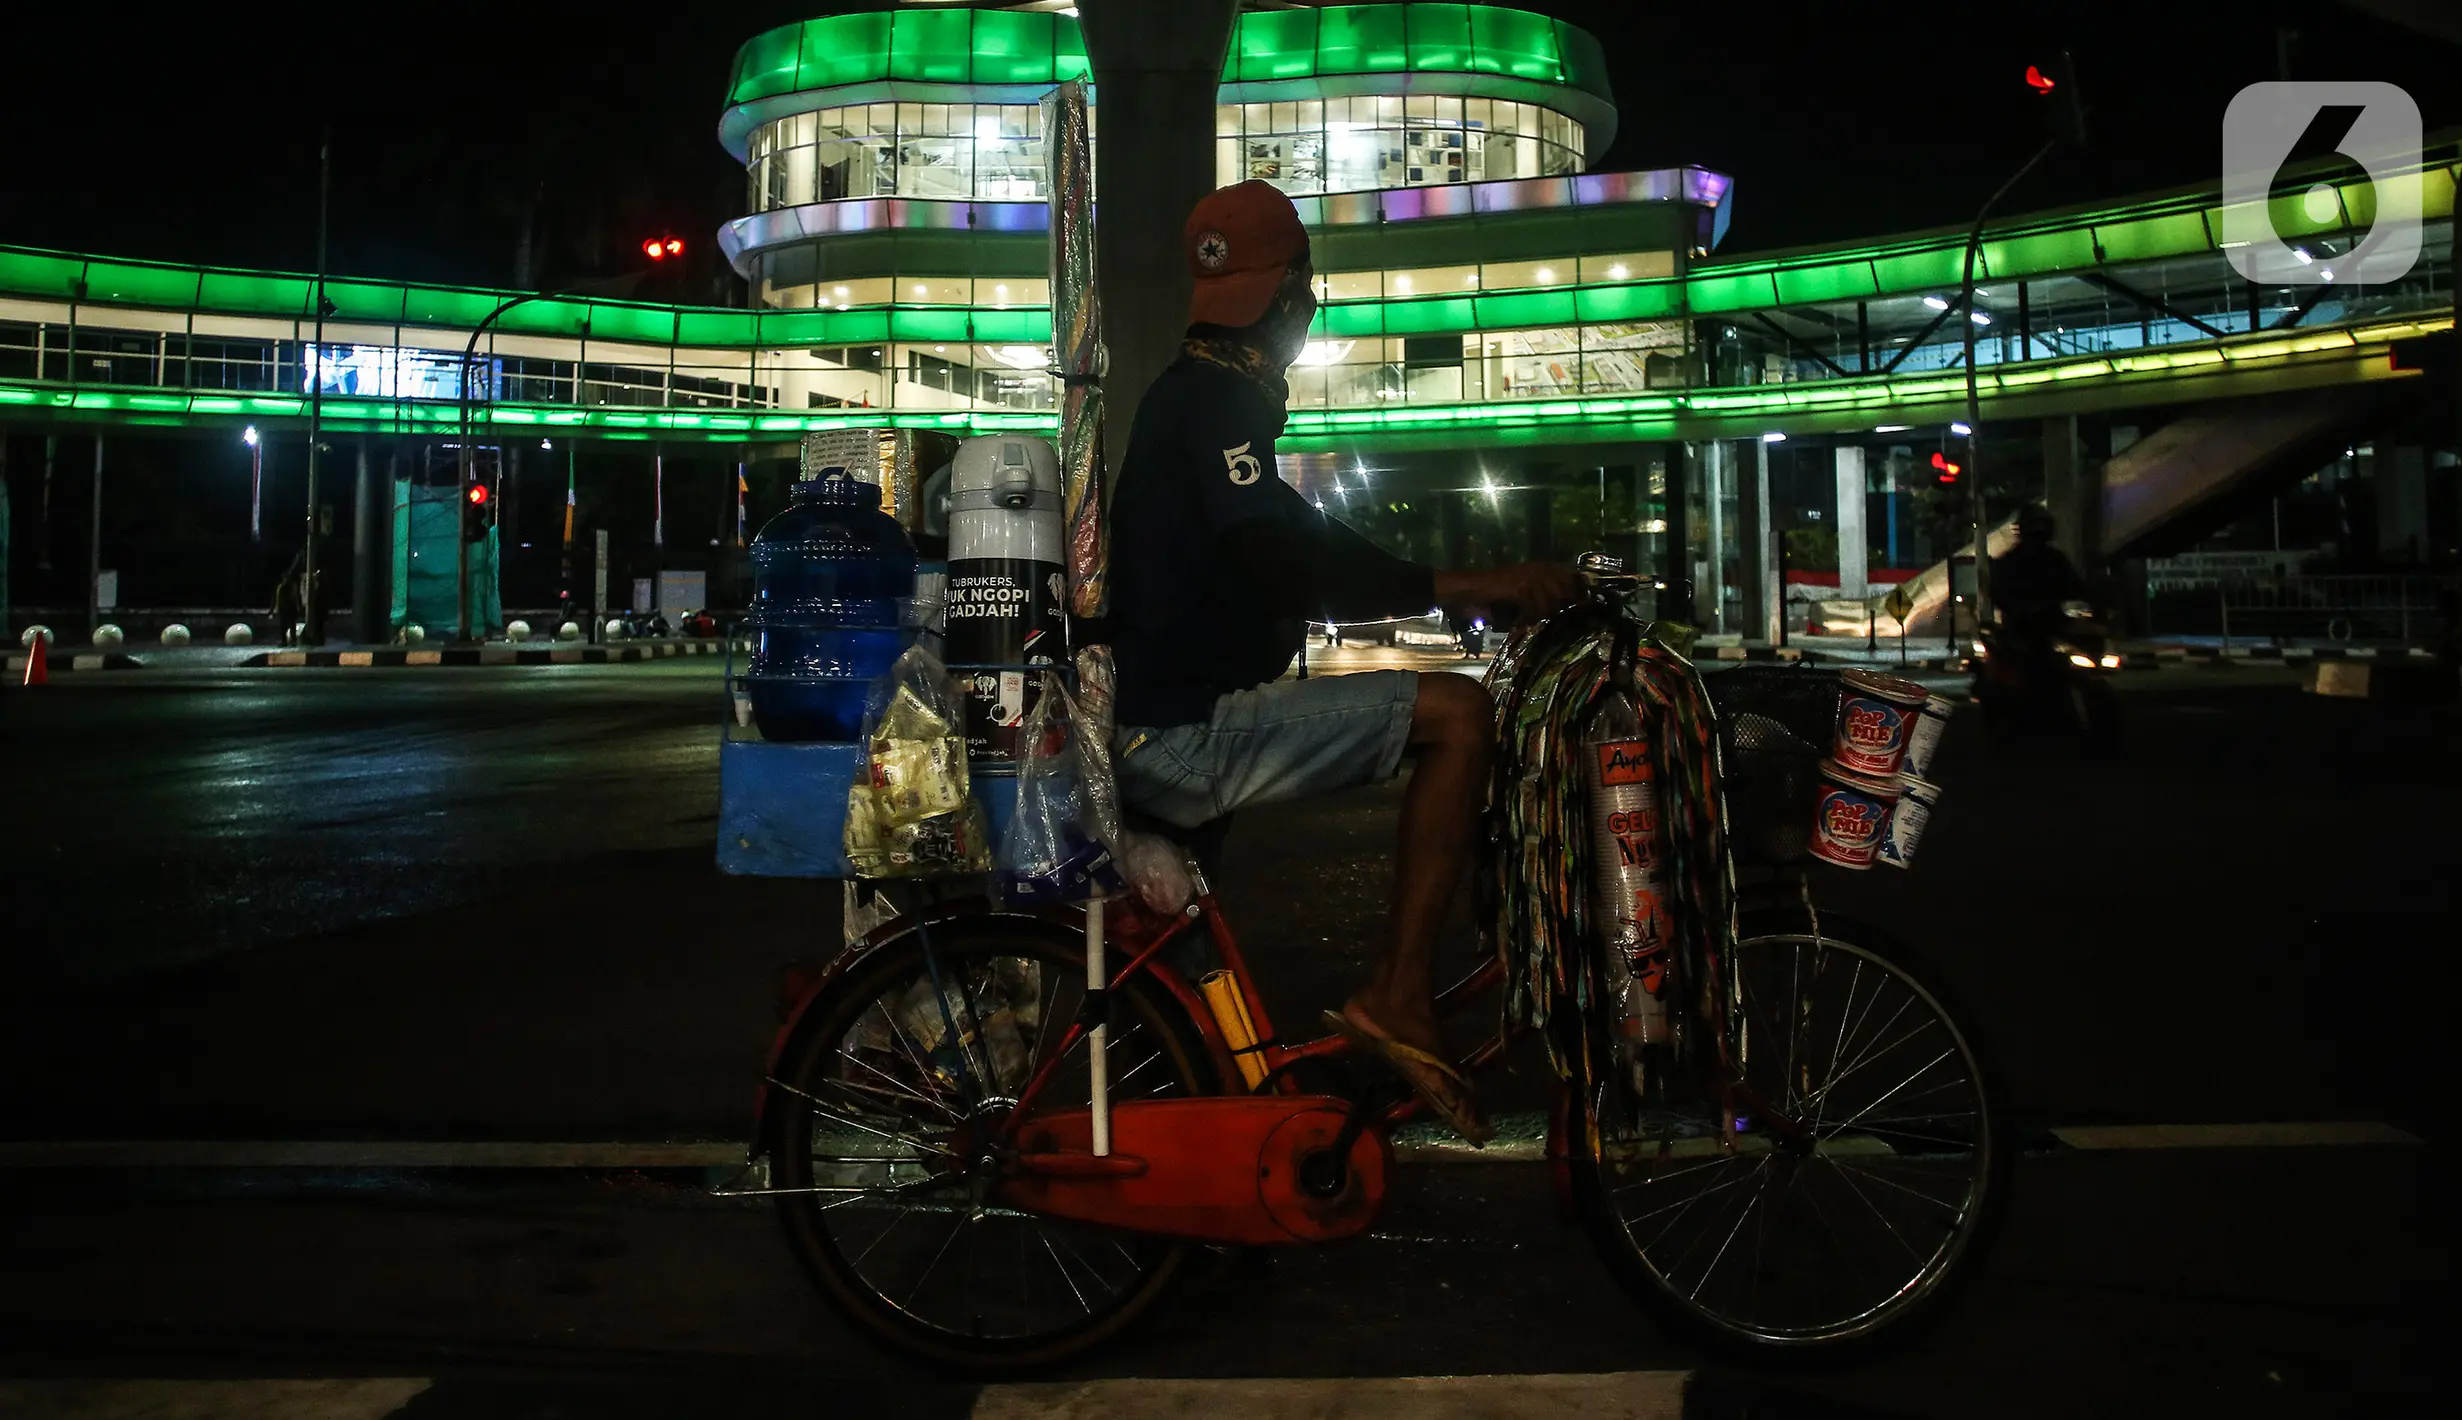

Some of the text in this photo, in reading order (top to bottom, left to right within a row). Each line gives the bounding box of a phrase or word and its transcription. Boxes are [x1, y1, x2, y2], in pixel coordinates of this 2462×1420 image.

[1222, 440, 1262, 487] 5
[952, 576, 1016, 588] TUBRUKERS,
[970, 588, 1030, 603] NGOPI
[949, 603, 1020, 619] GADJAH!
[1849, 704, 1886, 727] POP
[1850, 722, 1891, 742] MIE
[1830, 799, 1869, 821] POP
[1831, 816, 1874, 836] MIE
